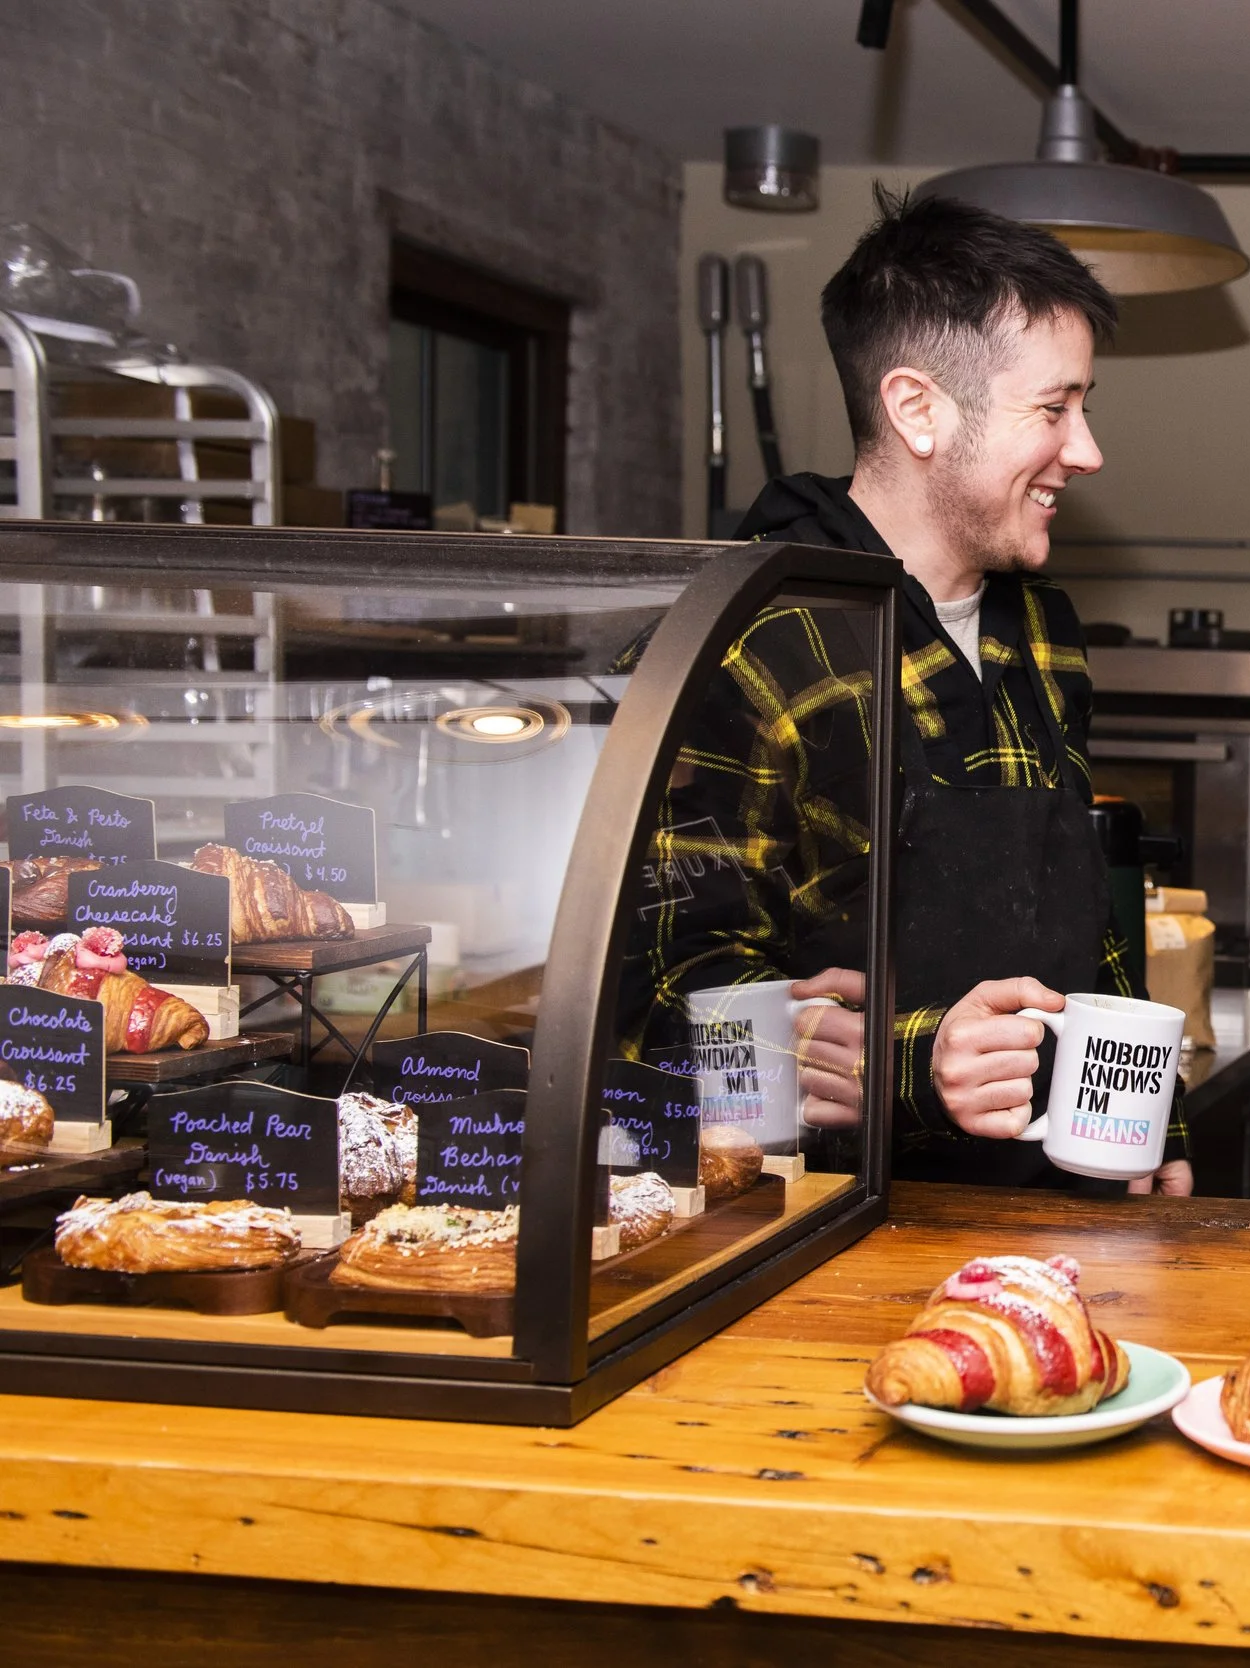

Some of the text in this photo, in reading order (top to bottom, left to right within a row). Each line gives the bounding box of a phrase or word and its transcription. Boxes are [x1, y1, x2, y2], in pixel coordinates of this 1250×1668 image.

[22, 803, 132, 828] Feta & Pesto
[258, 811, 325, 842] Pretzel
[40, 828, 94, 848] Danish
[245, 837, 327, 859] Croissant
[305, 863, 347, 882] $4.50
[88, 879, 178, 914] Cranberry
[75, 905, 178, 926] Cheesecake
[122, 929, 223, 949] ssant $6.25
[127, 952, 167, 969] egan)
[9, 1006, 93, 1033] Chocolate
[0, 1039, 91, 1066] Croissant
[1085, 1036, 1172, 1069] NOBODY
[401, 1056, 481, 1081] Almond
[1080, 1061, 1163, 1095] KNOWS
[24, 1072, 77, 1092] $6.25
[664, 1101, 701, 1118] $5.00
[1076, 1086, 1111, 1115] I'M
[169, 1111, 313, 1140] Poached Pear
[449, 1112, 526, 1135] Mushro
[611, 1116, 653, 1148] erry
[1073, 1110, 1149, 1145] TRANS
[184, 1142, 270, 1168] Danish
[155, 1169, 299, 1193] (vegan) $5.75
[420, 1174, 492, 1196] Danish
